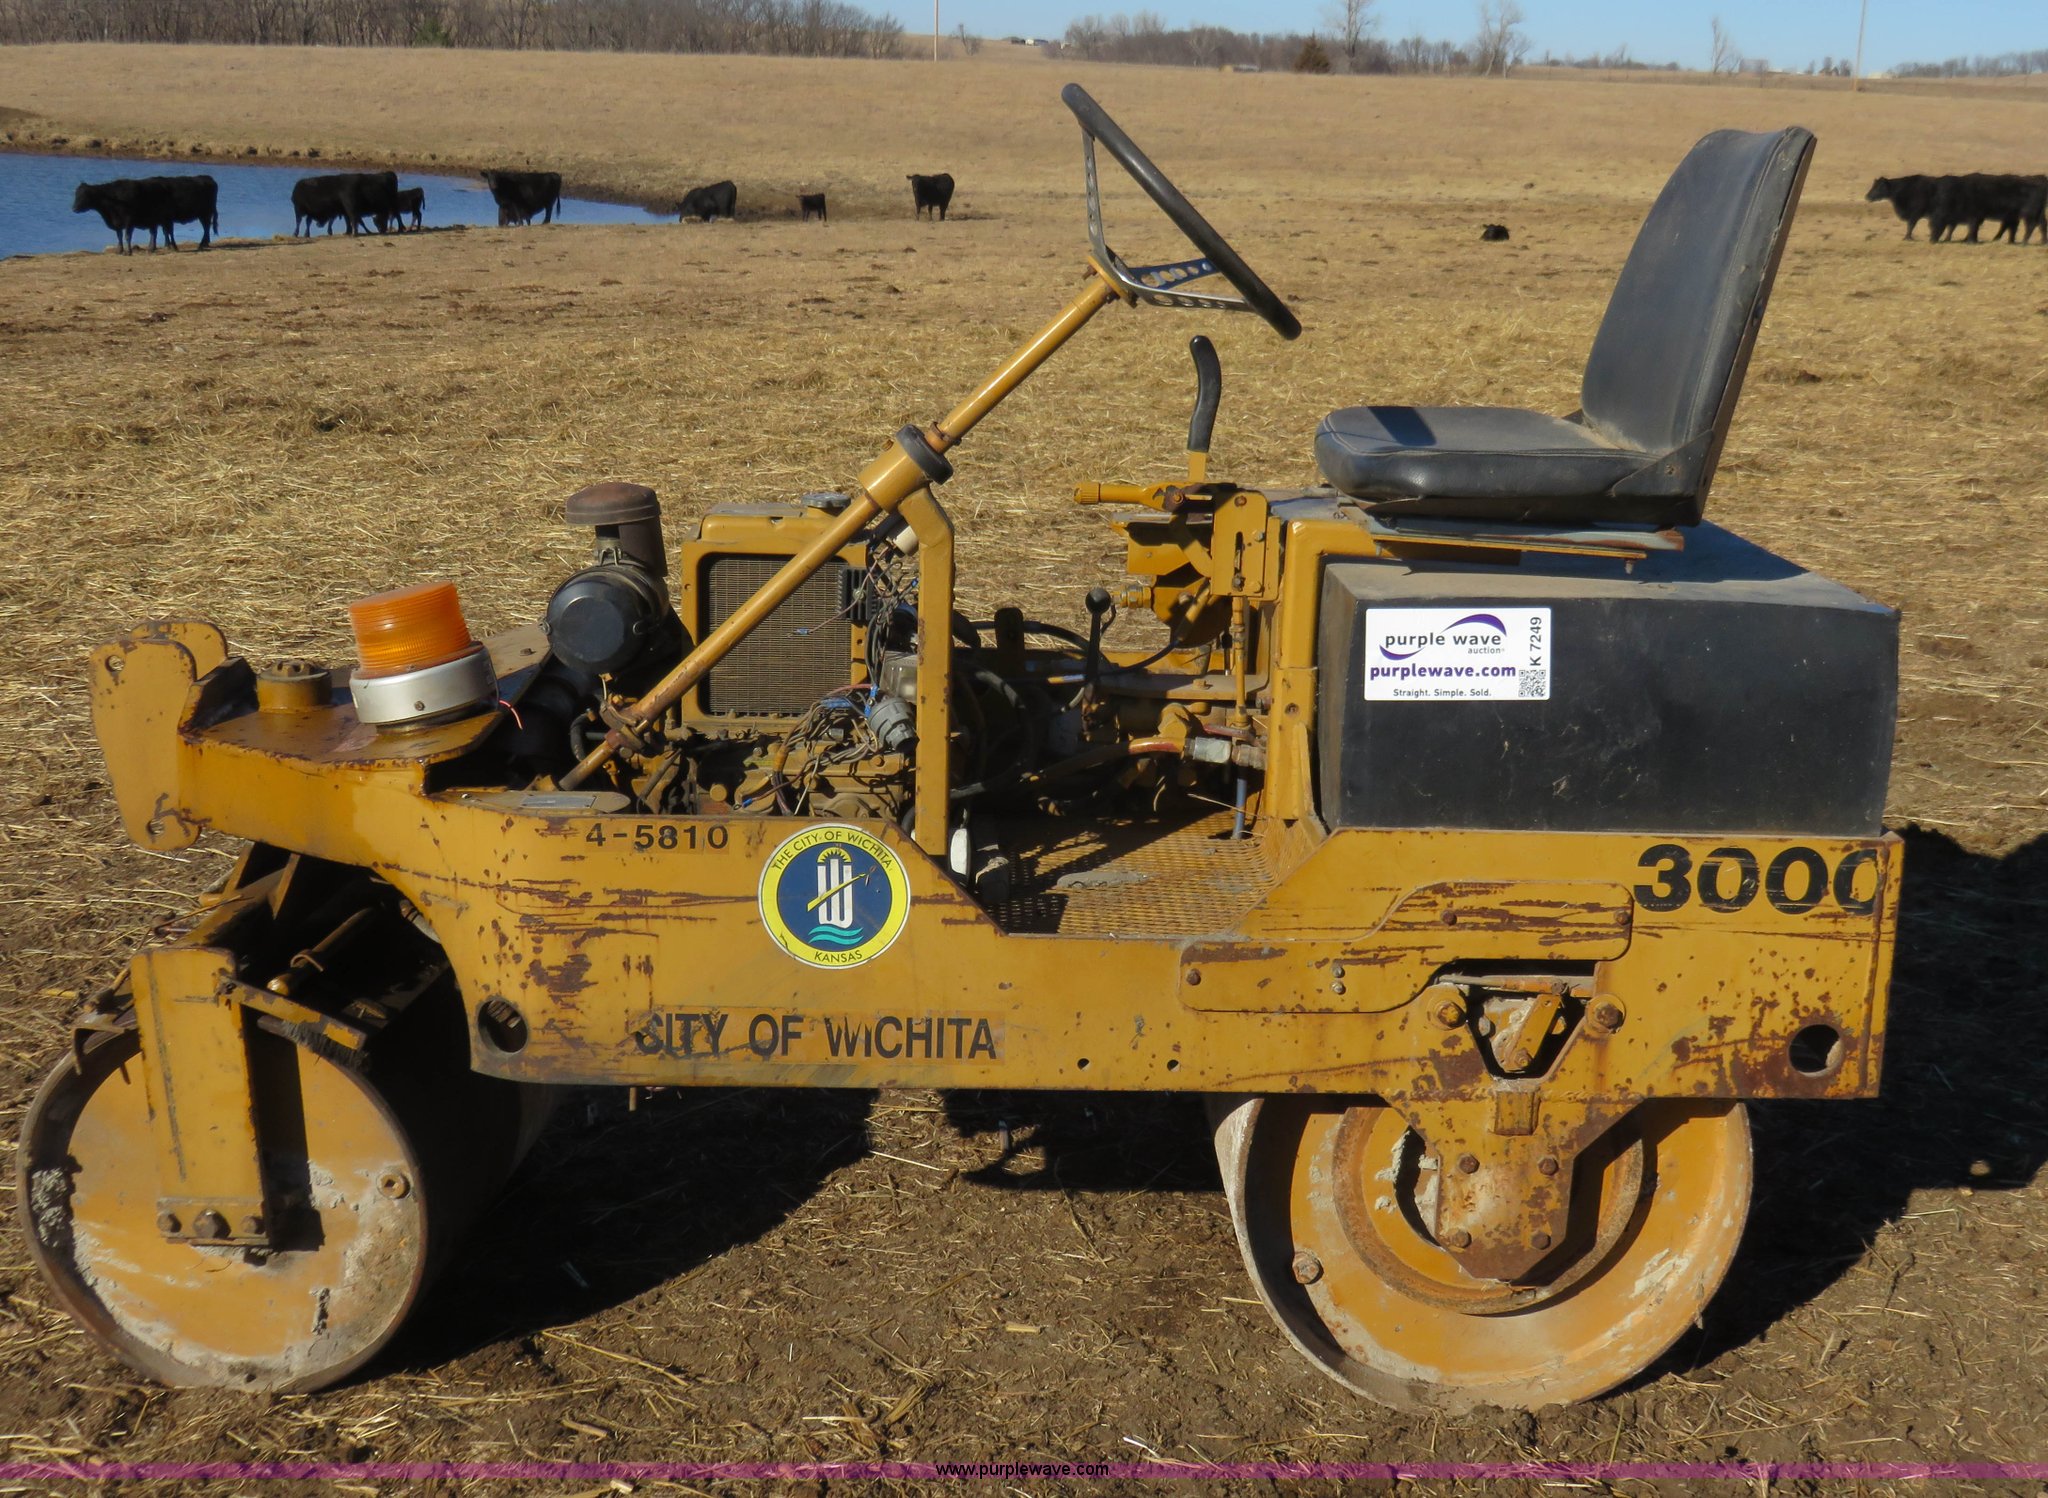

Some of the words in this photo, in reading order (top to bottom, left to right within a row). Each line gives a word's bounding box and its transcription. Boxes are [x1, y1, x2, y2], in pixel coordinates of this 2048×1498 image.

[1385, 632, 1445, 648] purple
[1453, 634, 1501, 646] wave
[1530, 617, 1542, 652] 7249
[1370, 663, 1516, 681] purplewave.com
[1530, 656, 1541, 666] K
[1393, 688, 1431, 698] Straight.
[1434, 688, 1467, 698] Simple.
[1470, 688, 1492, 697] Sold.
[585, 823, 729, 850] 4-5810
[772, 849, 793, 870] THE
[793, 833, 819, 850] CITY
[824, 830, 842, 841] OF
[847, 833, 893, 869] WICHITA
[1633, 843, 1881, 915] 3000
[814, 951, 863, 964] KANSAS
[748, 1014, 804, 1057] OF
[823, 1016, 997, 1059] WICHITA
